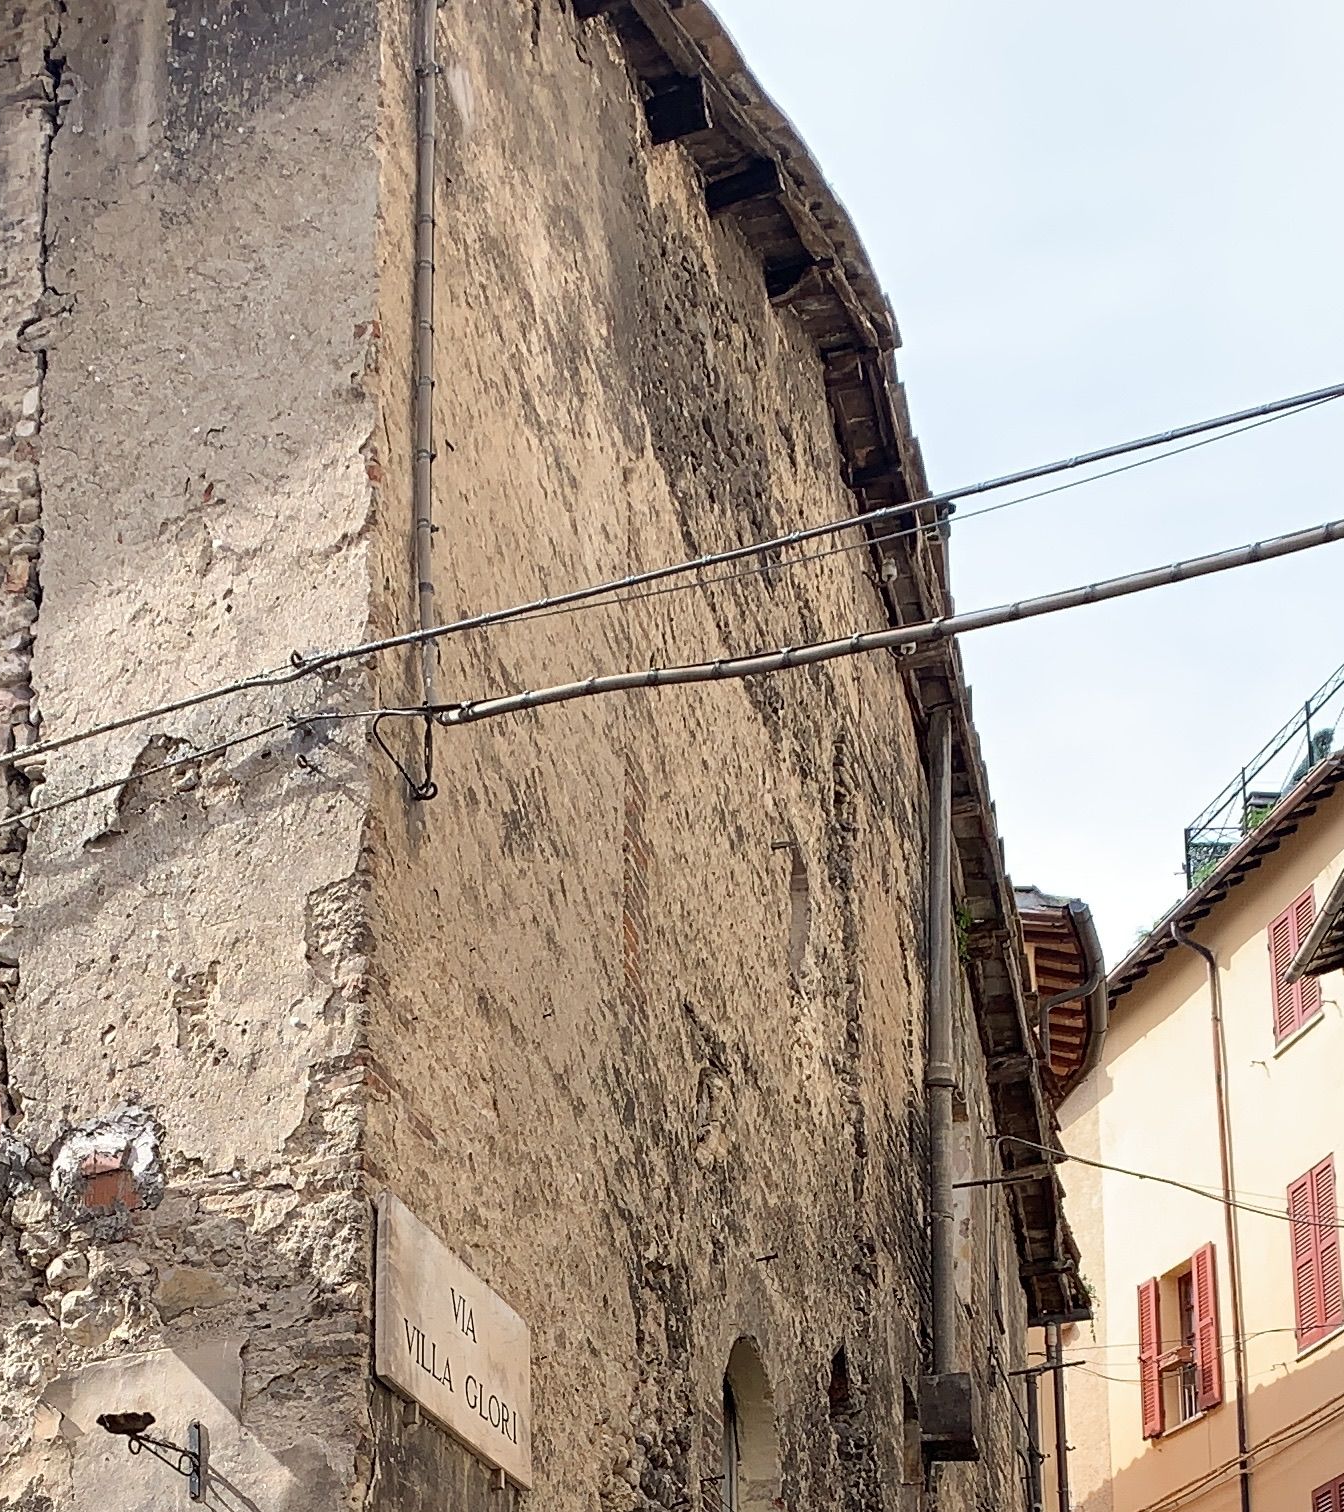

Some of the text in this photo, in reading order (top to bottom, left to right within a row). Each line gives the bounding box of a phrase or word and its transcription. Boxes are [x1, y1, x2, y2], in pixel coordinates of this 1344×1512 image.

[450, 1288, 477, 1343] VIA
[404, 1318, 517, 1444] VILLA GLORI
